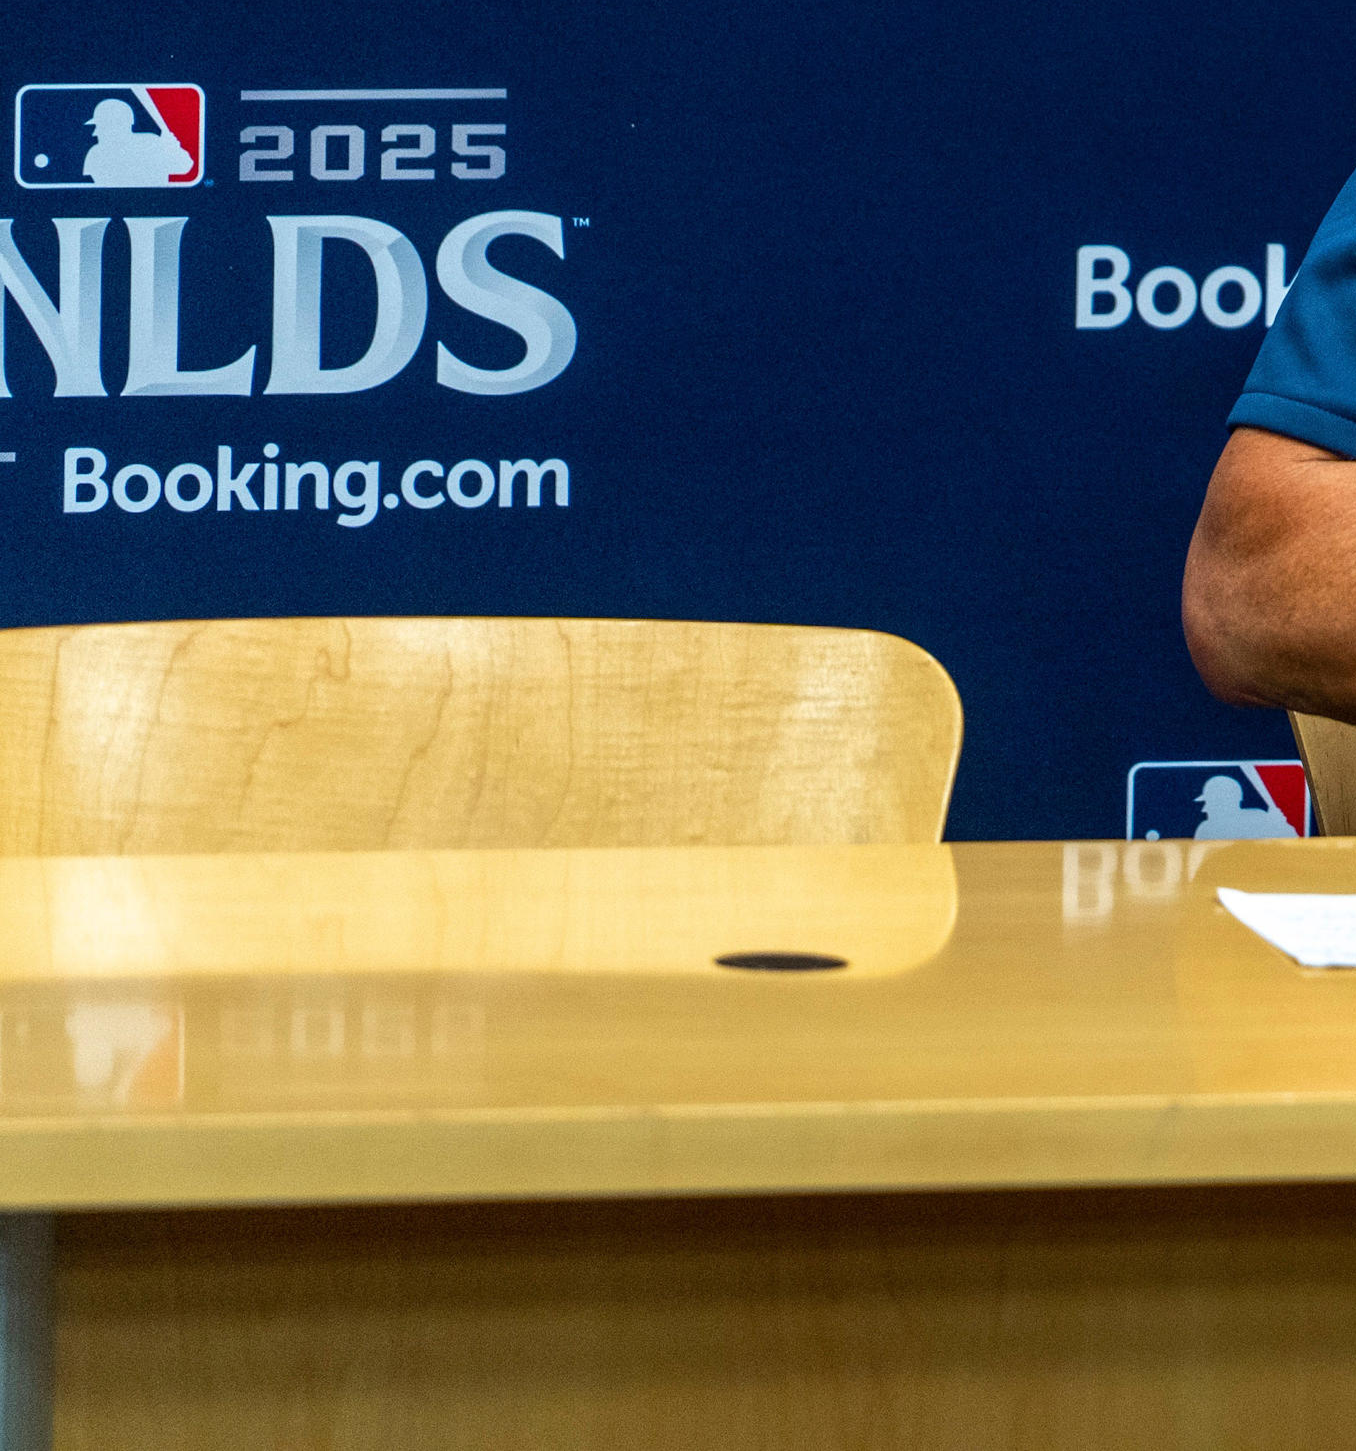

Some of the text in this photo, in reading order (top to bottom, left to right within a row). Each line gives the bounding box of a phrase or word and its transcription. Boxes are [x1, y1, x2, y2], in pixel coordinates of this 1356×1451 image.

[238, 123, 508, 182] 2025
[0, 209, 578, 398] NLDS
[62, 442, 570, 529] Booking.com
